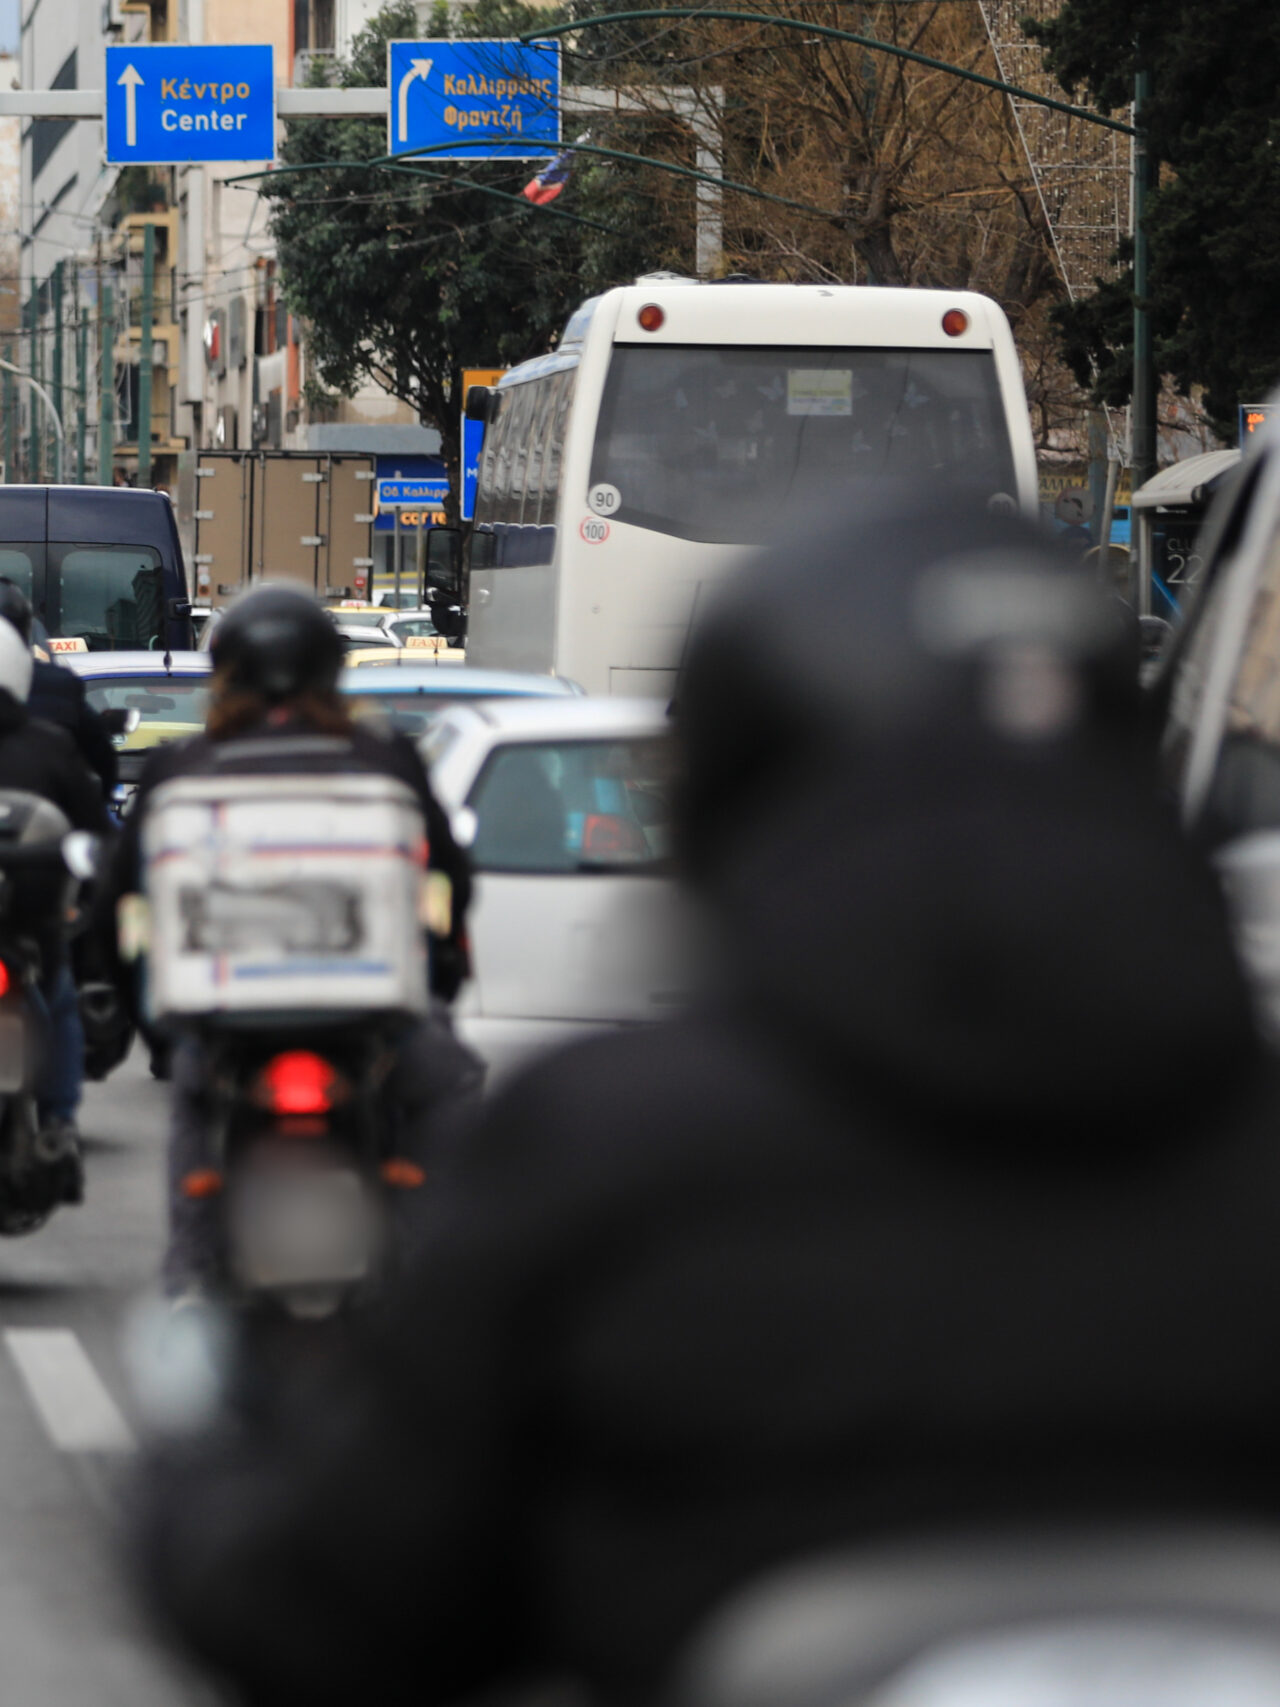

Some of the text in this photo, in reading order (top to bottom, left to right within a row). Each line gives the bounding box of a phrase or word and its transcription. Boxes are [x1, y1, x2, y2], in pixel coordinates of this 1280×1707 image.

[160, 77, 251, 104] Κέντρο
[160, 108, 248, 131] Center
[443, 105, 523, 132] Φραντζή
[595, 492, 615, 507] 90
[585, 524, 605, 540] 100
[1166, 554, 1205, 583] 22
[47, 641, 78, 652] TAXI
[410, 637, 444, 648] TAXI
